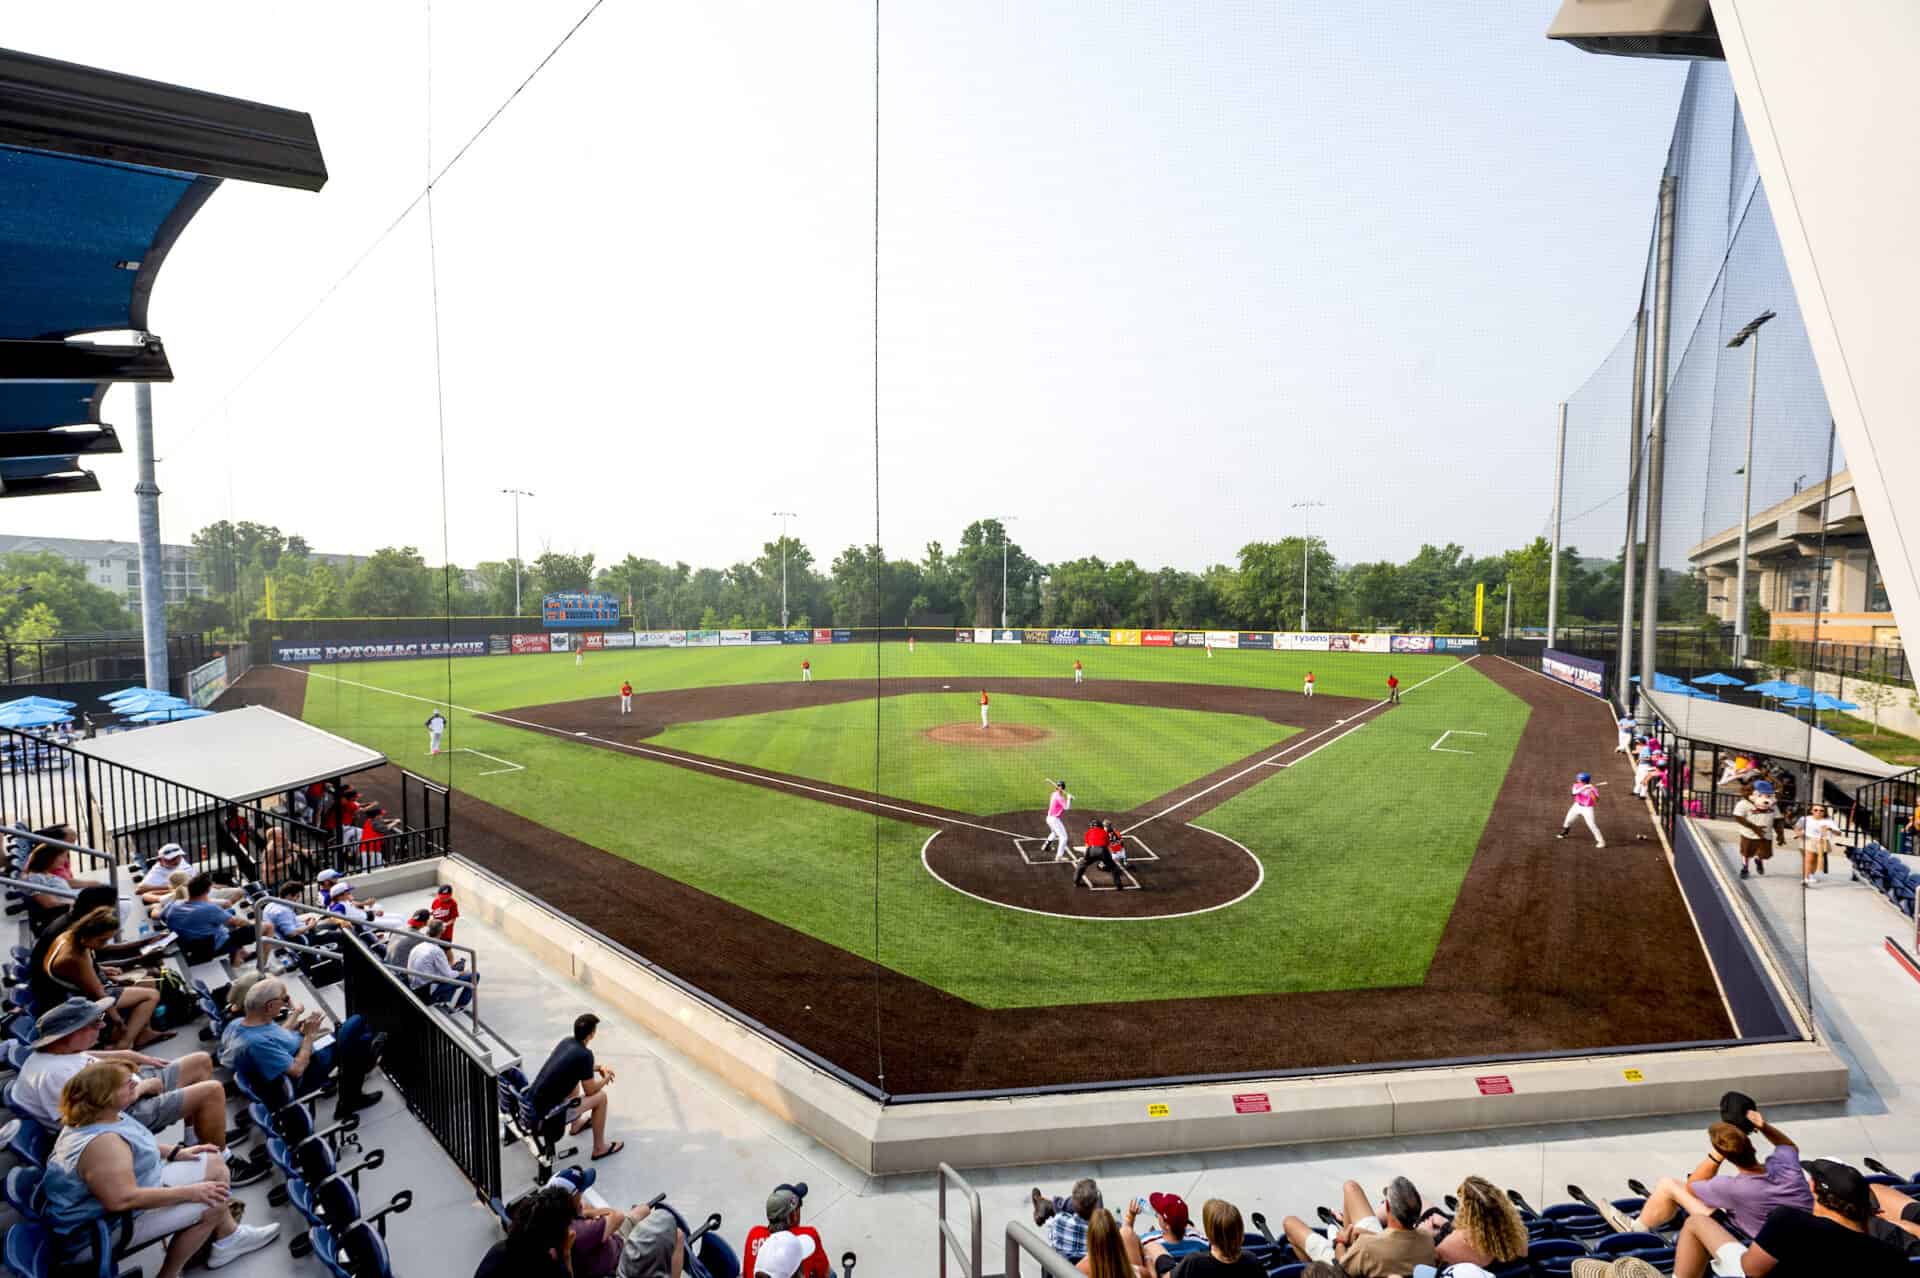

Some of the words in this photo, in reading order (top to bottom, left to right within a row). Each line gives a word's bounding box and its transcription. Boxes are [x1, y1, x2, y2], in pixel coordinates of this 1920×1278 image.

[279, 647, 321, 661] THE
[325, 644, 417, 659] POTOMAC
[421, 641, 484, 655] LEAGUE
